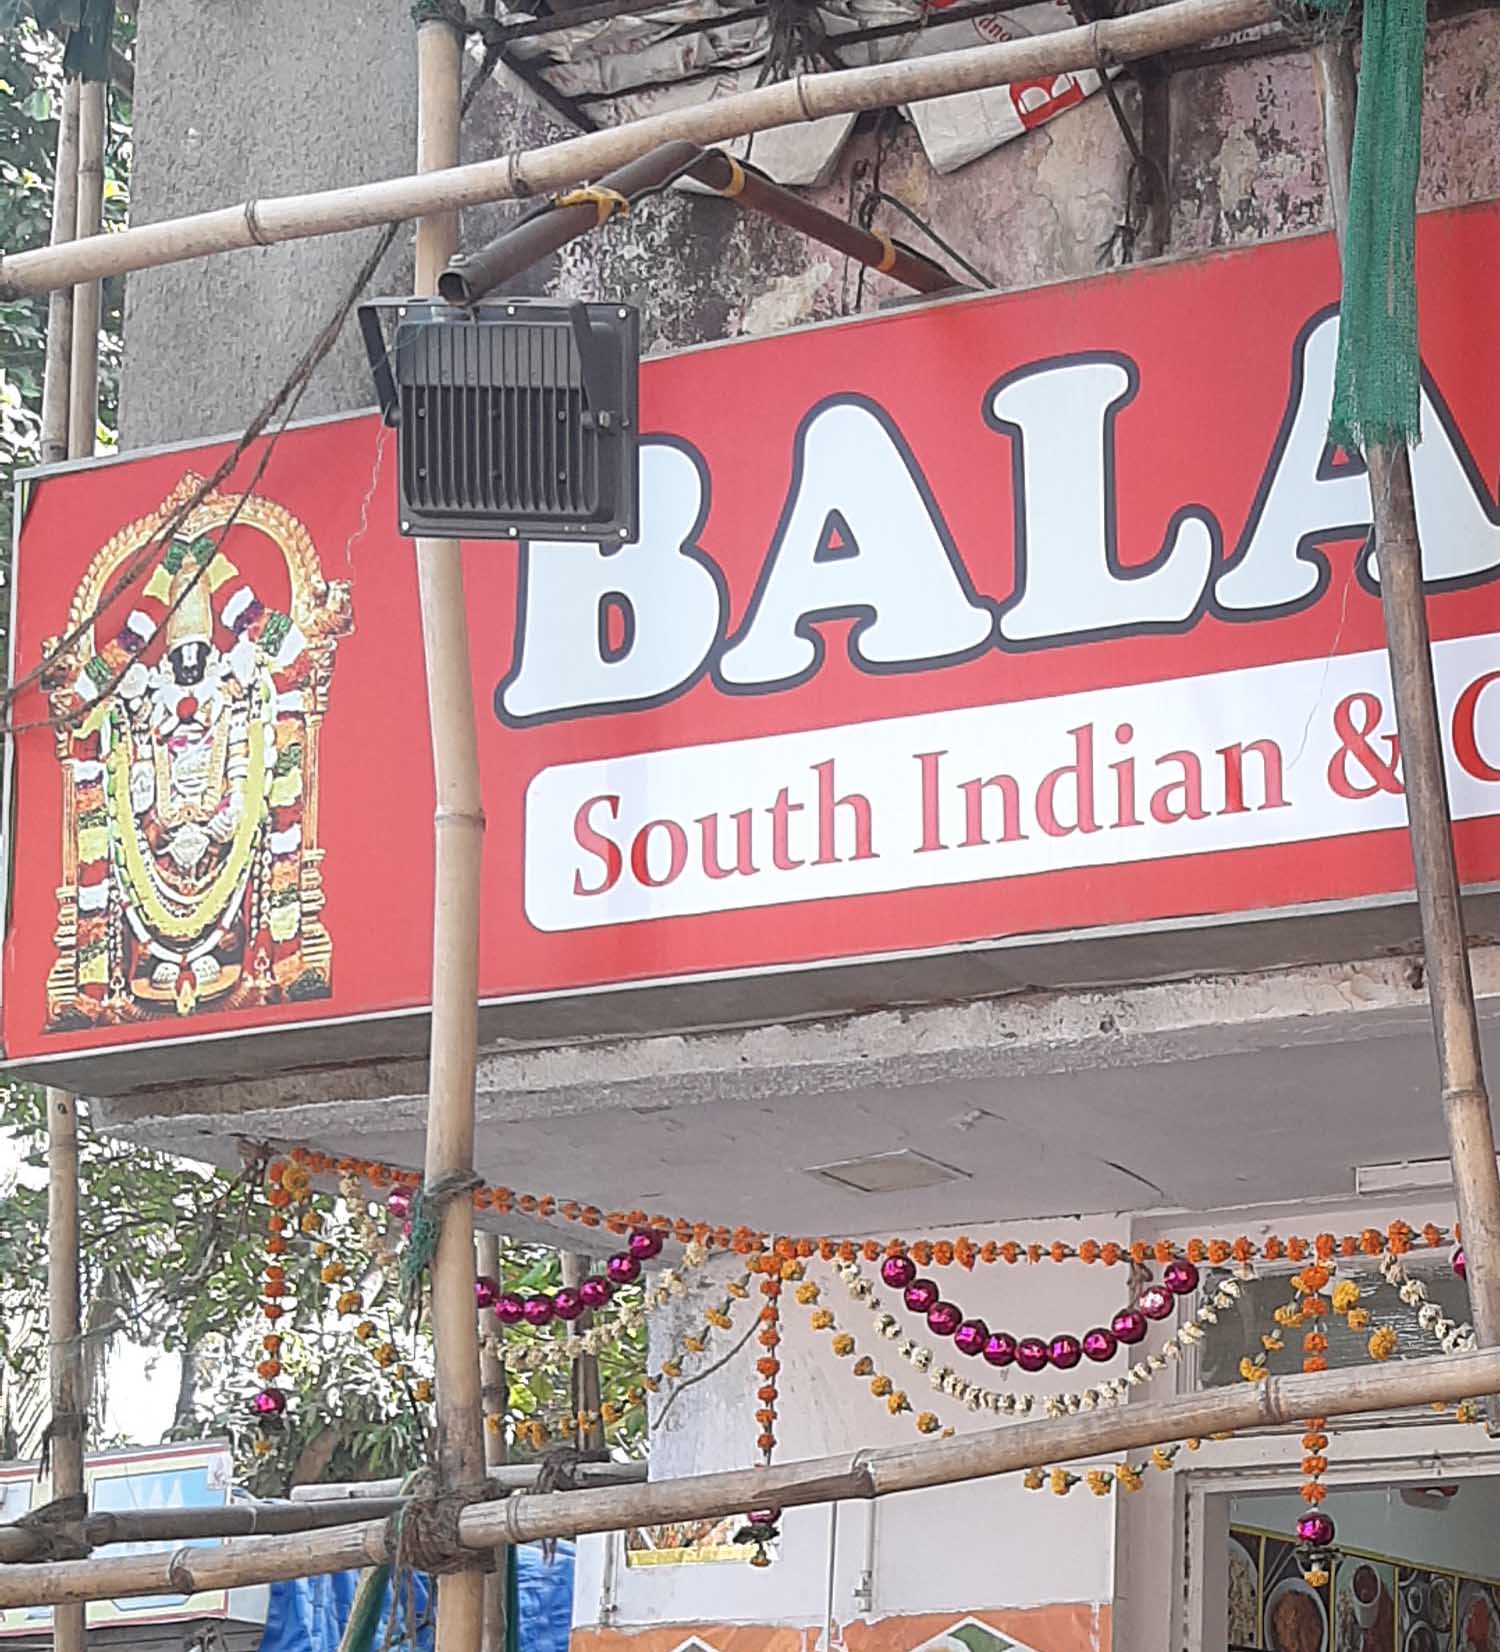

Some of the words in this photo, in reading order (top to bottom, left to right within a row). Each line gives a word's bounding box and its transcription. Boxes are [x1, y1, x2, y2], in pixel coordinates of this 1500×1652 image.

[572, 756, 880, 897] South
[912, 720, 1288, 855] Indian
[1326, 691, 1406, 799] &
